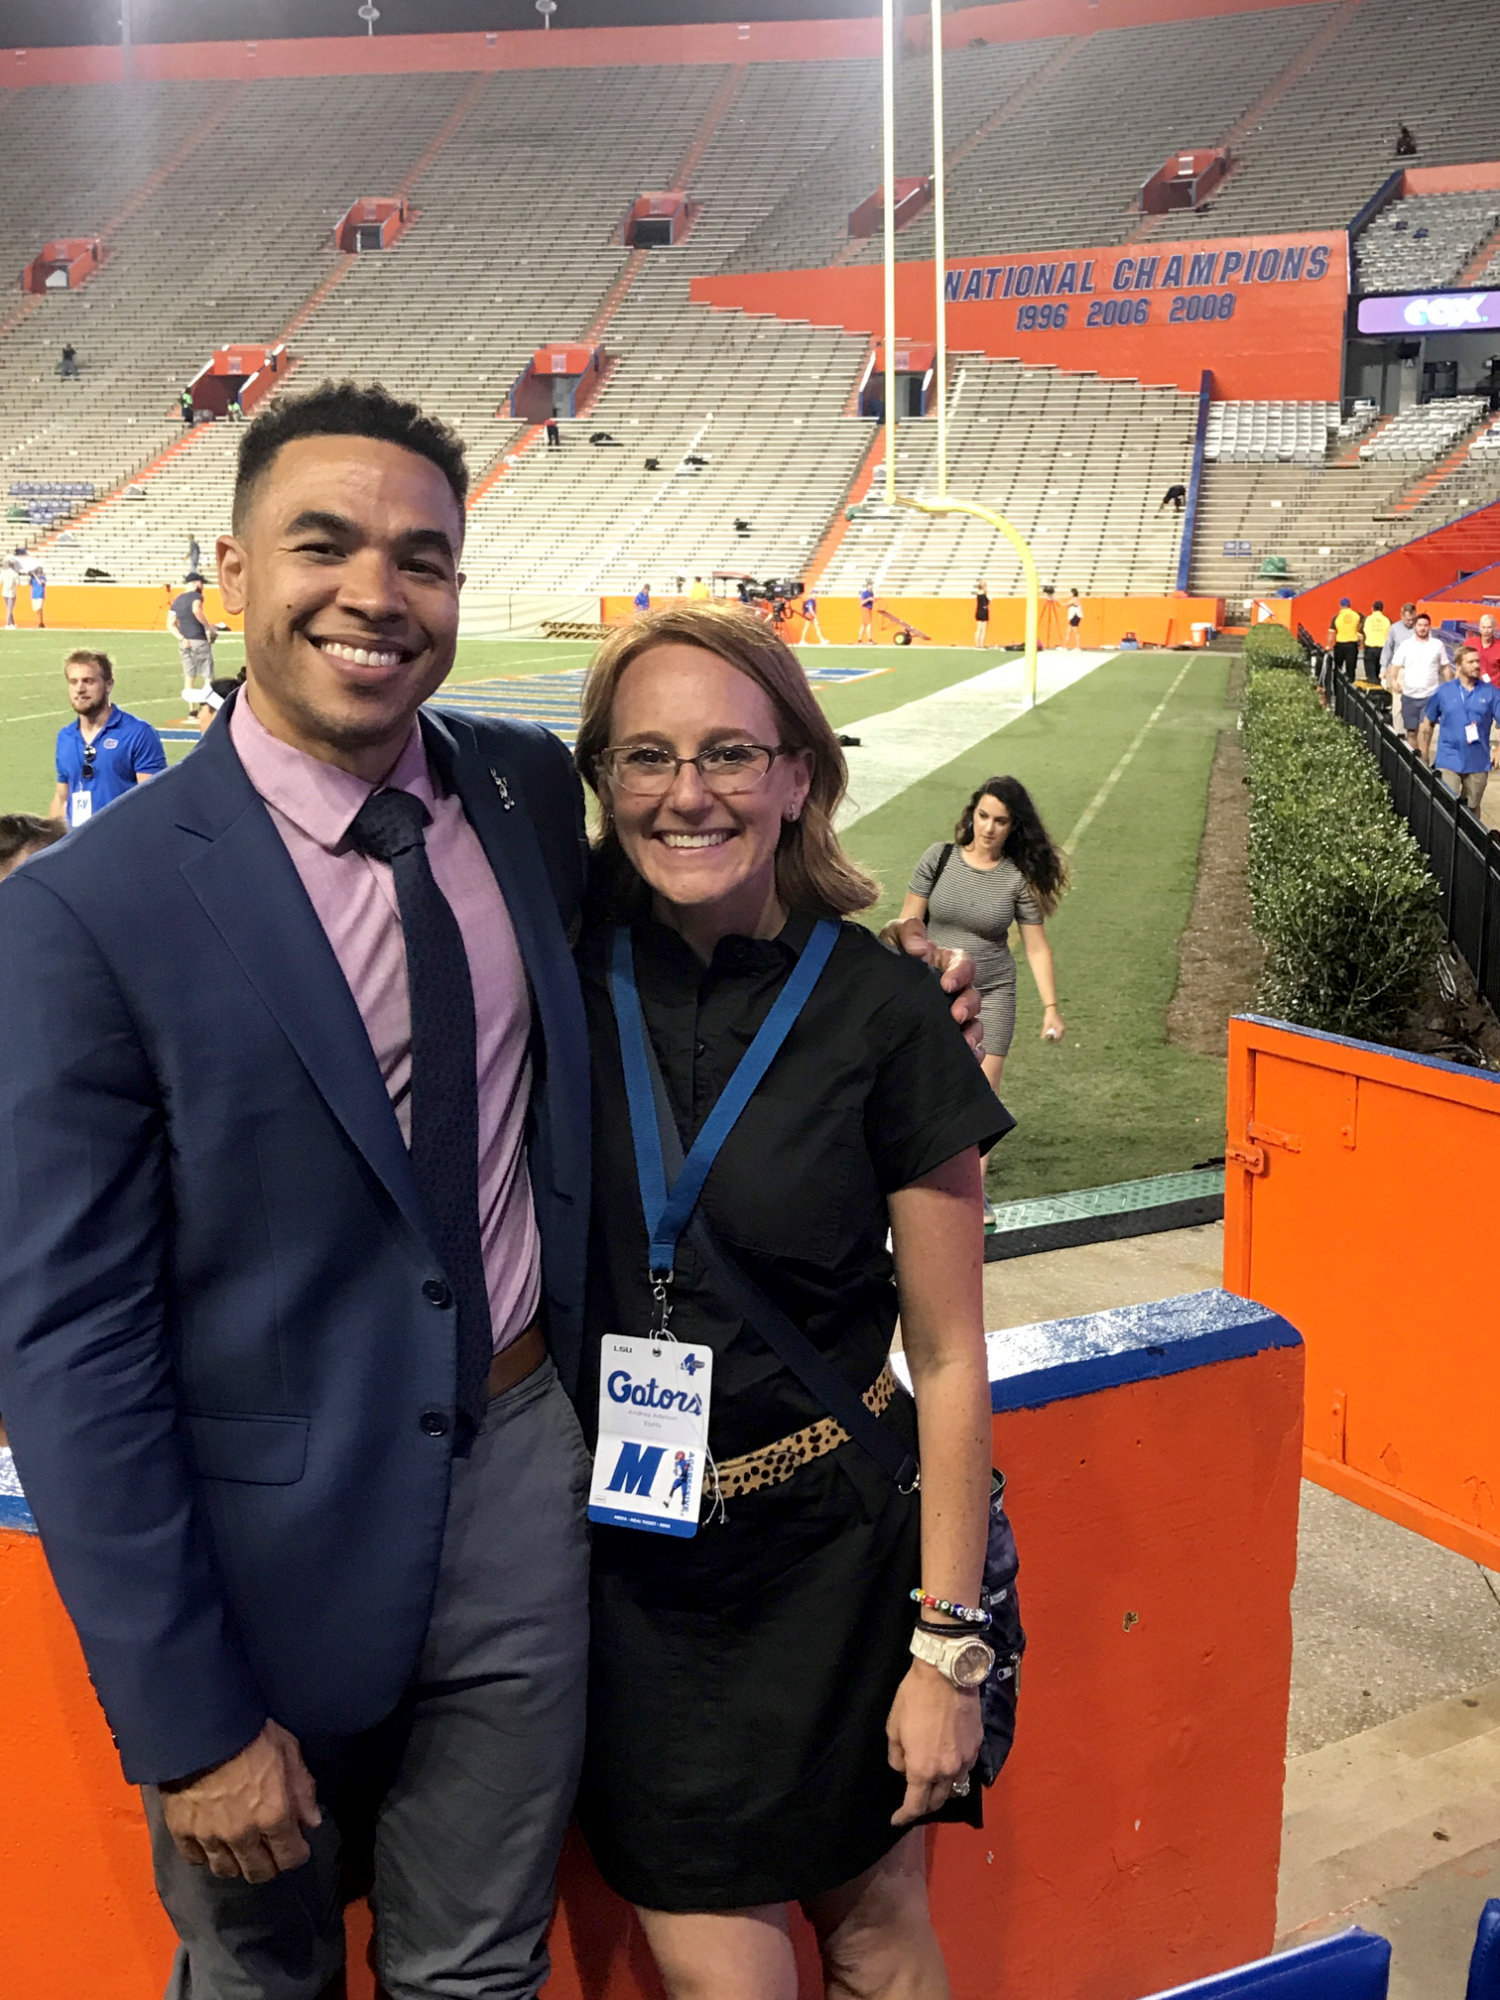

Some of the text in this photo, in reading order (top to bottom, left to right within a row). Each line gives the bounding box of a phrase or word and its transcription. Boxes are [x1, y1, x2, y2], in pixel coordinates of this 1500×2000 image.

[945, 245, 1331, 303] NATIONAL CHAMPIONS
[1016, 292, 1236, 332] 1996 2006 2008
[613, 1345, 633, 1354] LSU
[607, 1370, 702, 1416] Gators
[604, 1440, 669, 1498] M
